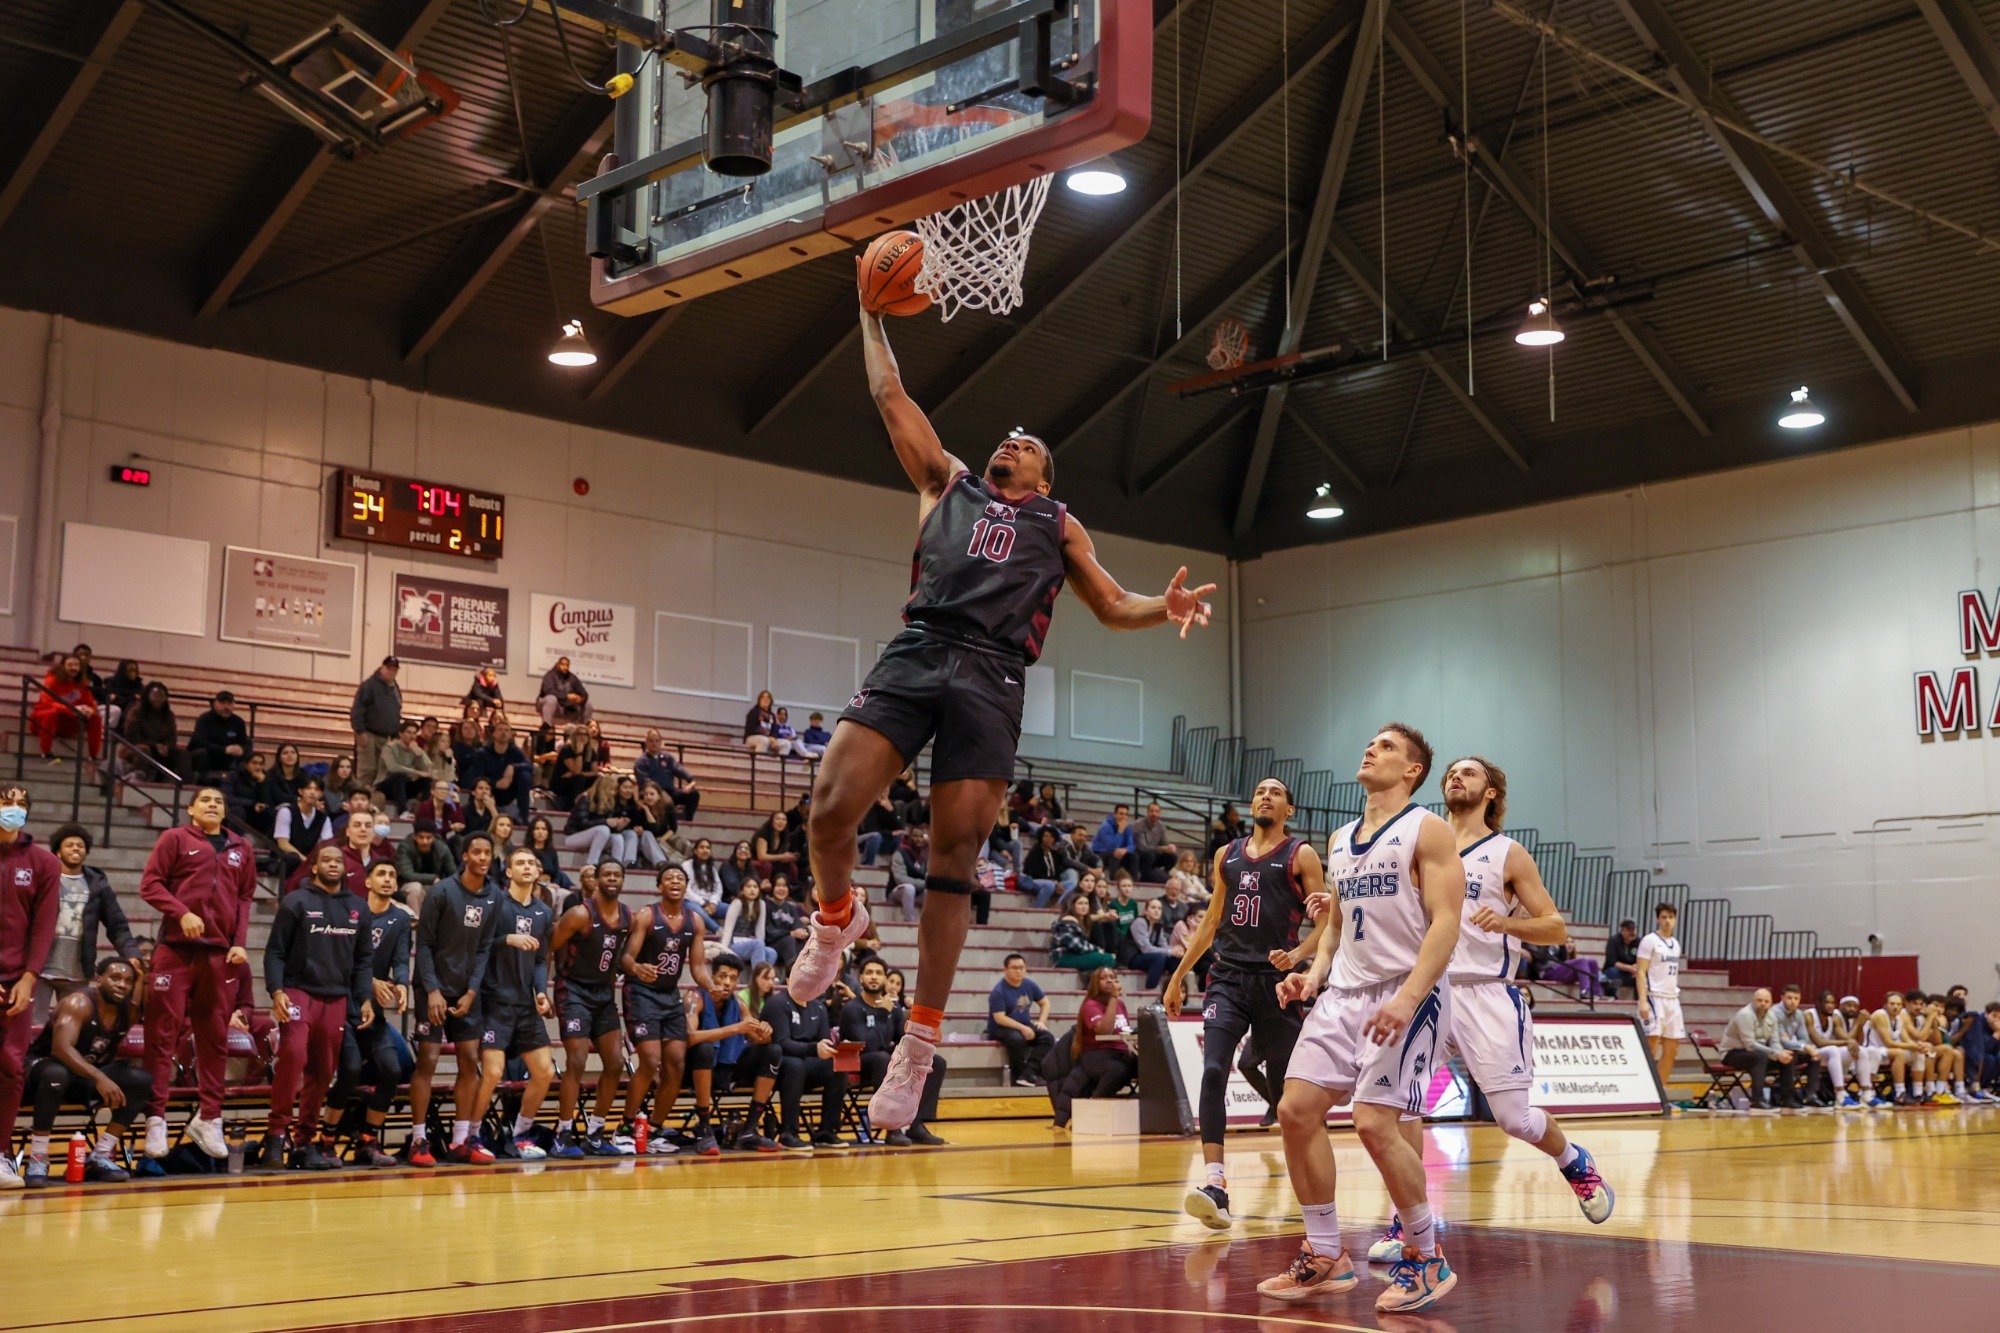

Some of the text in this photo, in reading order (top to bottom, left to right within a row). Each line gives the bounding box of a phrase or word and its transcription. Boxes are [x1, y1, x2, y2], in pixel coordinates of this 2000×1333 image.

[877, 236, 919, 273] Wilson
[353, 475, 381, 491] Home
[353, 491, 384, 522] 34
[409, 483, 461, 517] 7:04
[468, 493, 501, 511] Guests
[409, 530, 441, 545] period
[481, 513, 502, 540] 11
[449, 529, 462, 550] 2
[967, 518, 1016, 563] 10
[450, 596, 500, 614] PREPARE.
[450, 608, 496, 625] PERSIST.
[549, 601, 614, 634] Campus
[450, 621, 503, 638] PERFORM.
[575, 625, 610, 647] Store
[1914, 666, 2000, 735] M
[1335, 872, 1399, 903] AKERS
[1231, 894, 1261, 927] 31
[1351, 905, 1366, 942] 2
[599, 950, 613, 971] 6
[656, 952, 680, 975] 23
[1533, 1035, 1625, 1050] McMASTER
[1540, 1054, 1628, 1066] MARAUDERS
[1552, 1081, 1620, 1096] @McMasterSports
